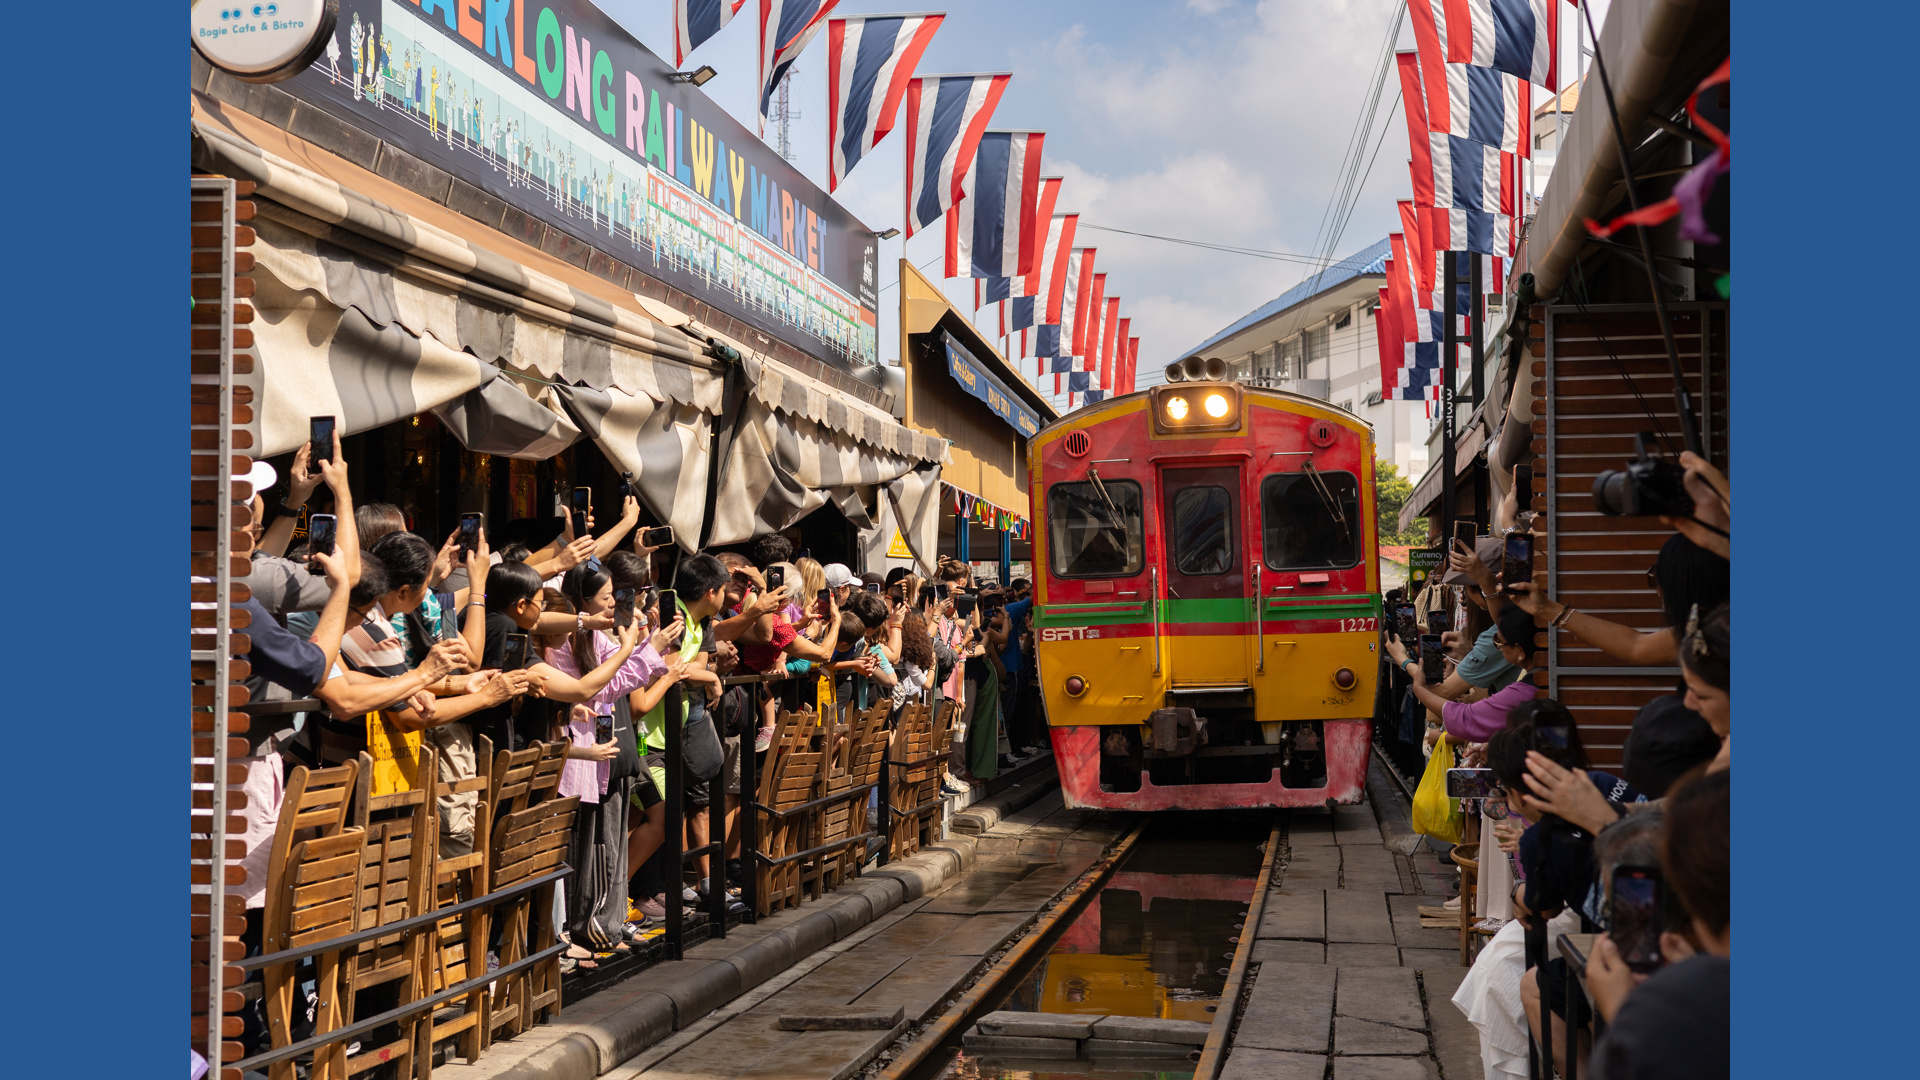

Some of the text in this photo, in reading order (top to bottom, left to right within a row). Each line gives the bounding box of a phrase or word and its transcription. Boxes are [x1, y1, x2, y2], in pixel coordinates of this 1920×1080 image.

[199, 19, 304, 39] Bogie Cafe & Bistro
[409, 0, 827, 277] EKLONG RAILWAY MARKET
[1411, 551, 1443, 560] Currency
[1339, 618, 1376, 633] 1227
[1042, 626, 1089, 642] SRT
